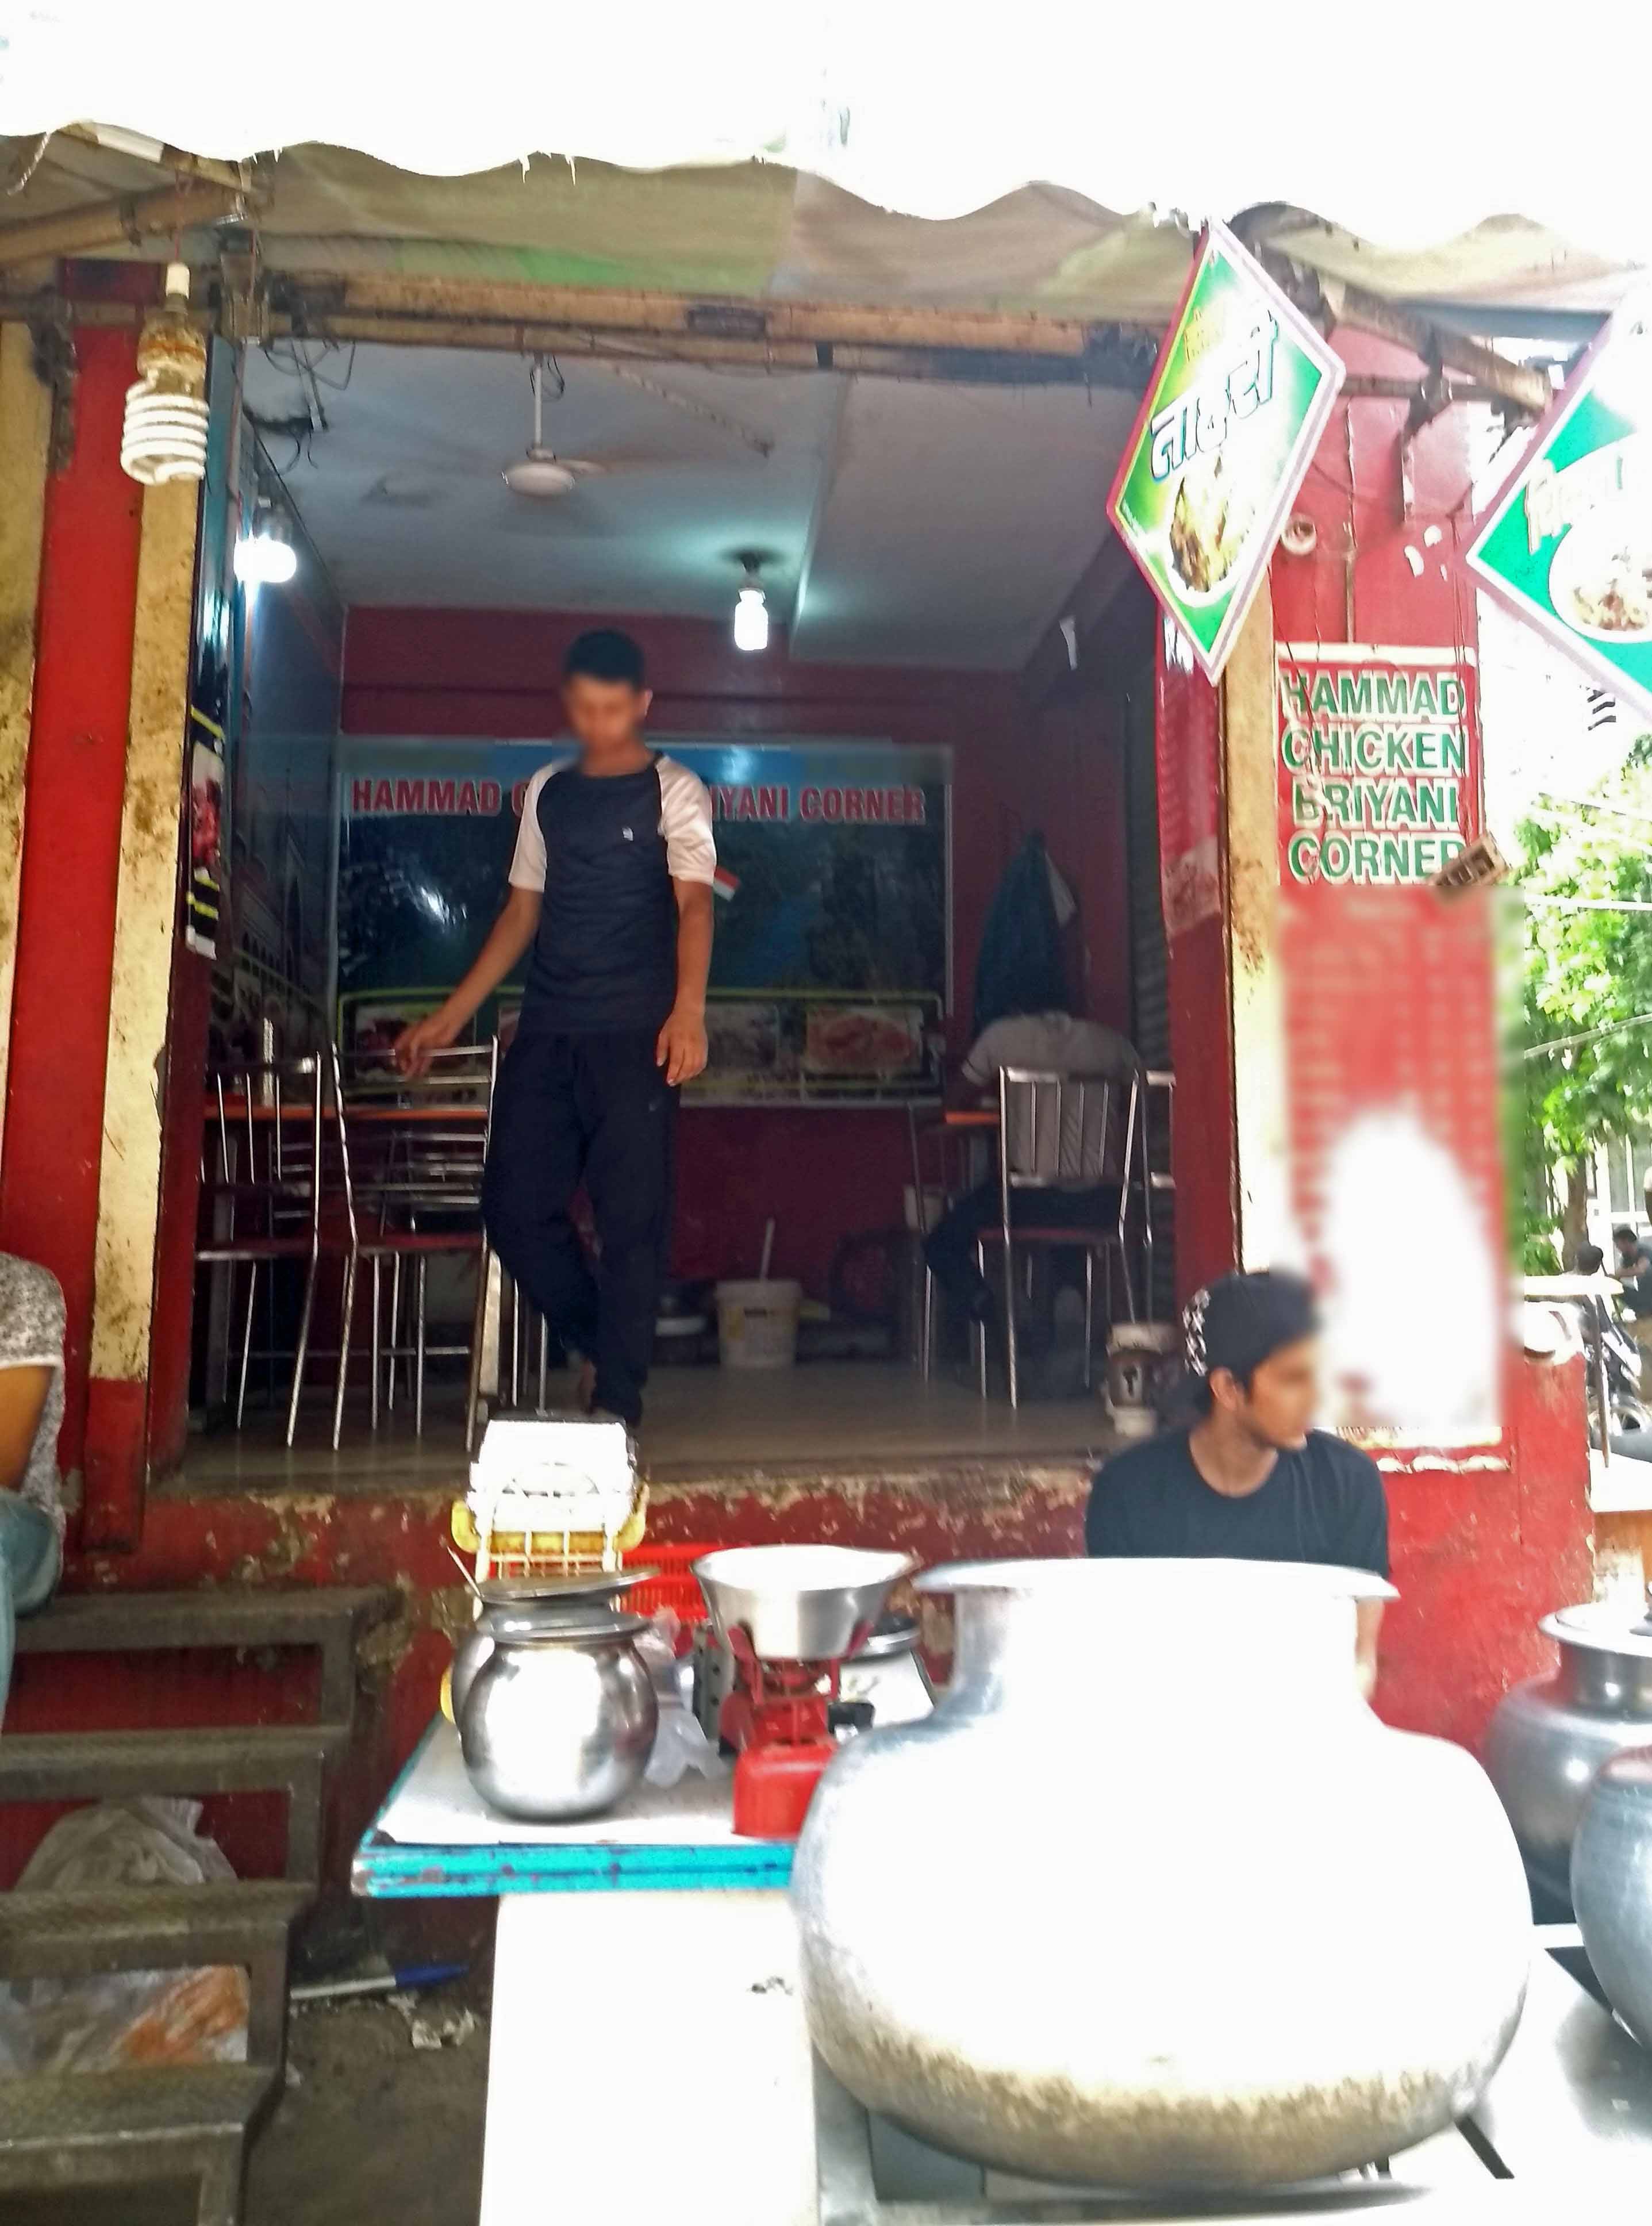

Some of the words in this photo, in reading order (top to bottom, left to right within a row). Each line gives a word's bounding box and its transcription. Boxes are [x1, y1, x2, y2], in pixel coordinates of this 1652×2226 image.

[1281, 671, 1466, 720] HAMMAD
[1282, 725, 1467, 776] CHICKEN
[351, 778, 502, 816] HAMMAD
[711, 785, 790, 821] IYANI
[800, 788, 926, 825] CORNER
[1293, 779, 1459, 828] BRIYANI
